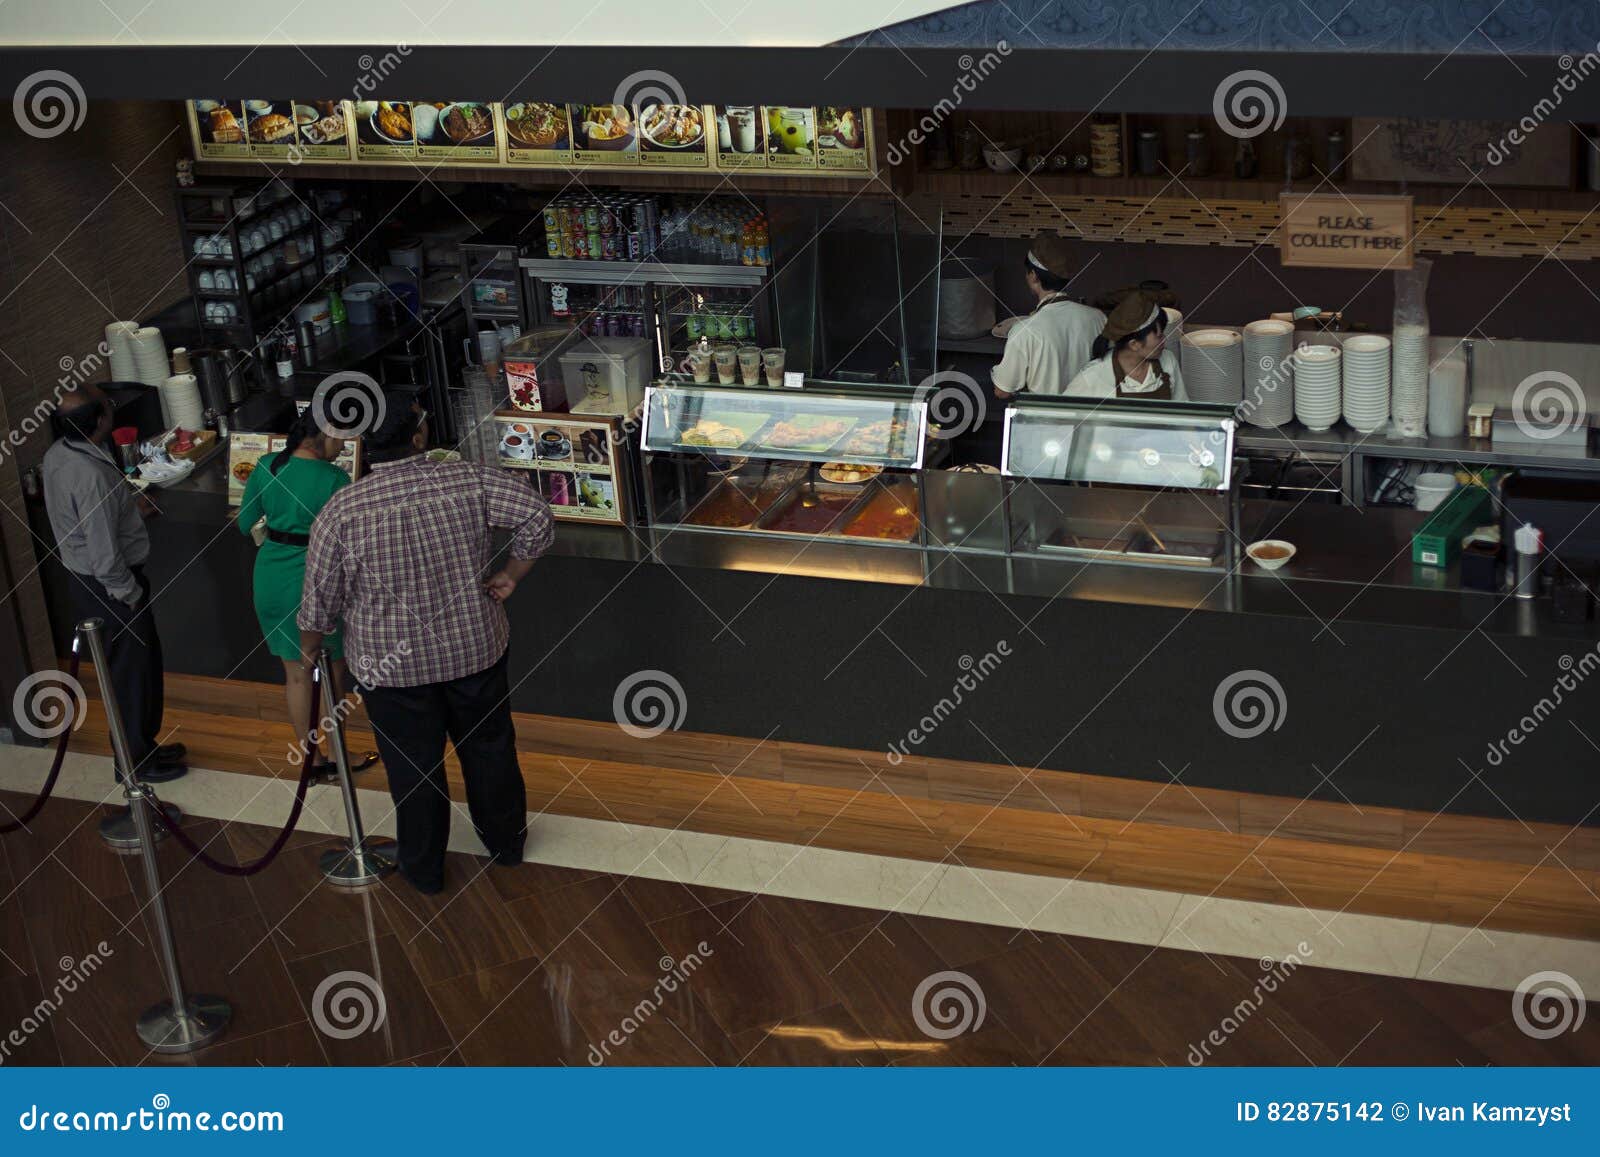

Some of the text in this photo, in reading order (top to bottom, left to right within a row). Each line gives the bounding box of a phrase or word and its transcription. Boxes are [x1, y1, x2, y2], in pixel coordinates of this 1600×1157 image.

[1318, 215, 1374, 231] PLEASE
[1290, 233, 1402, 250] COLLECT HERE
